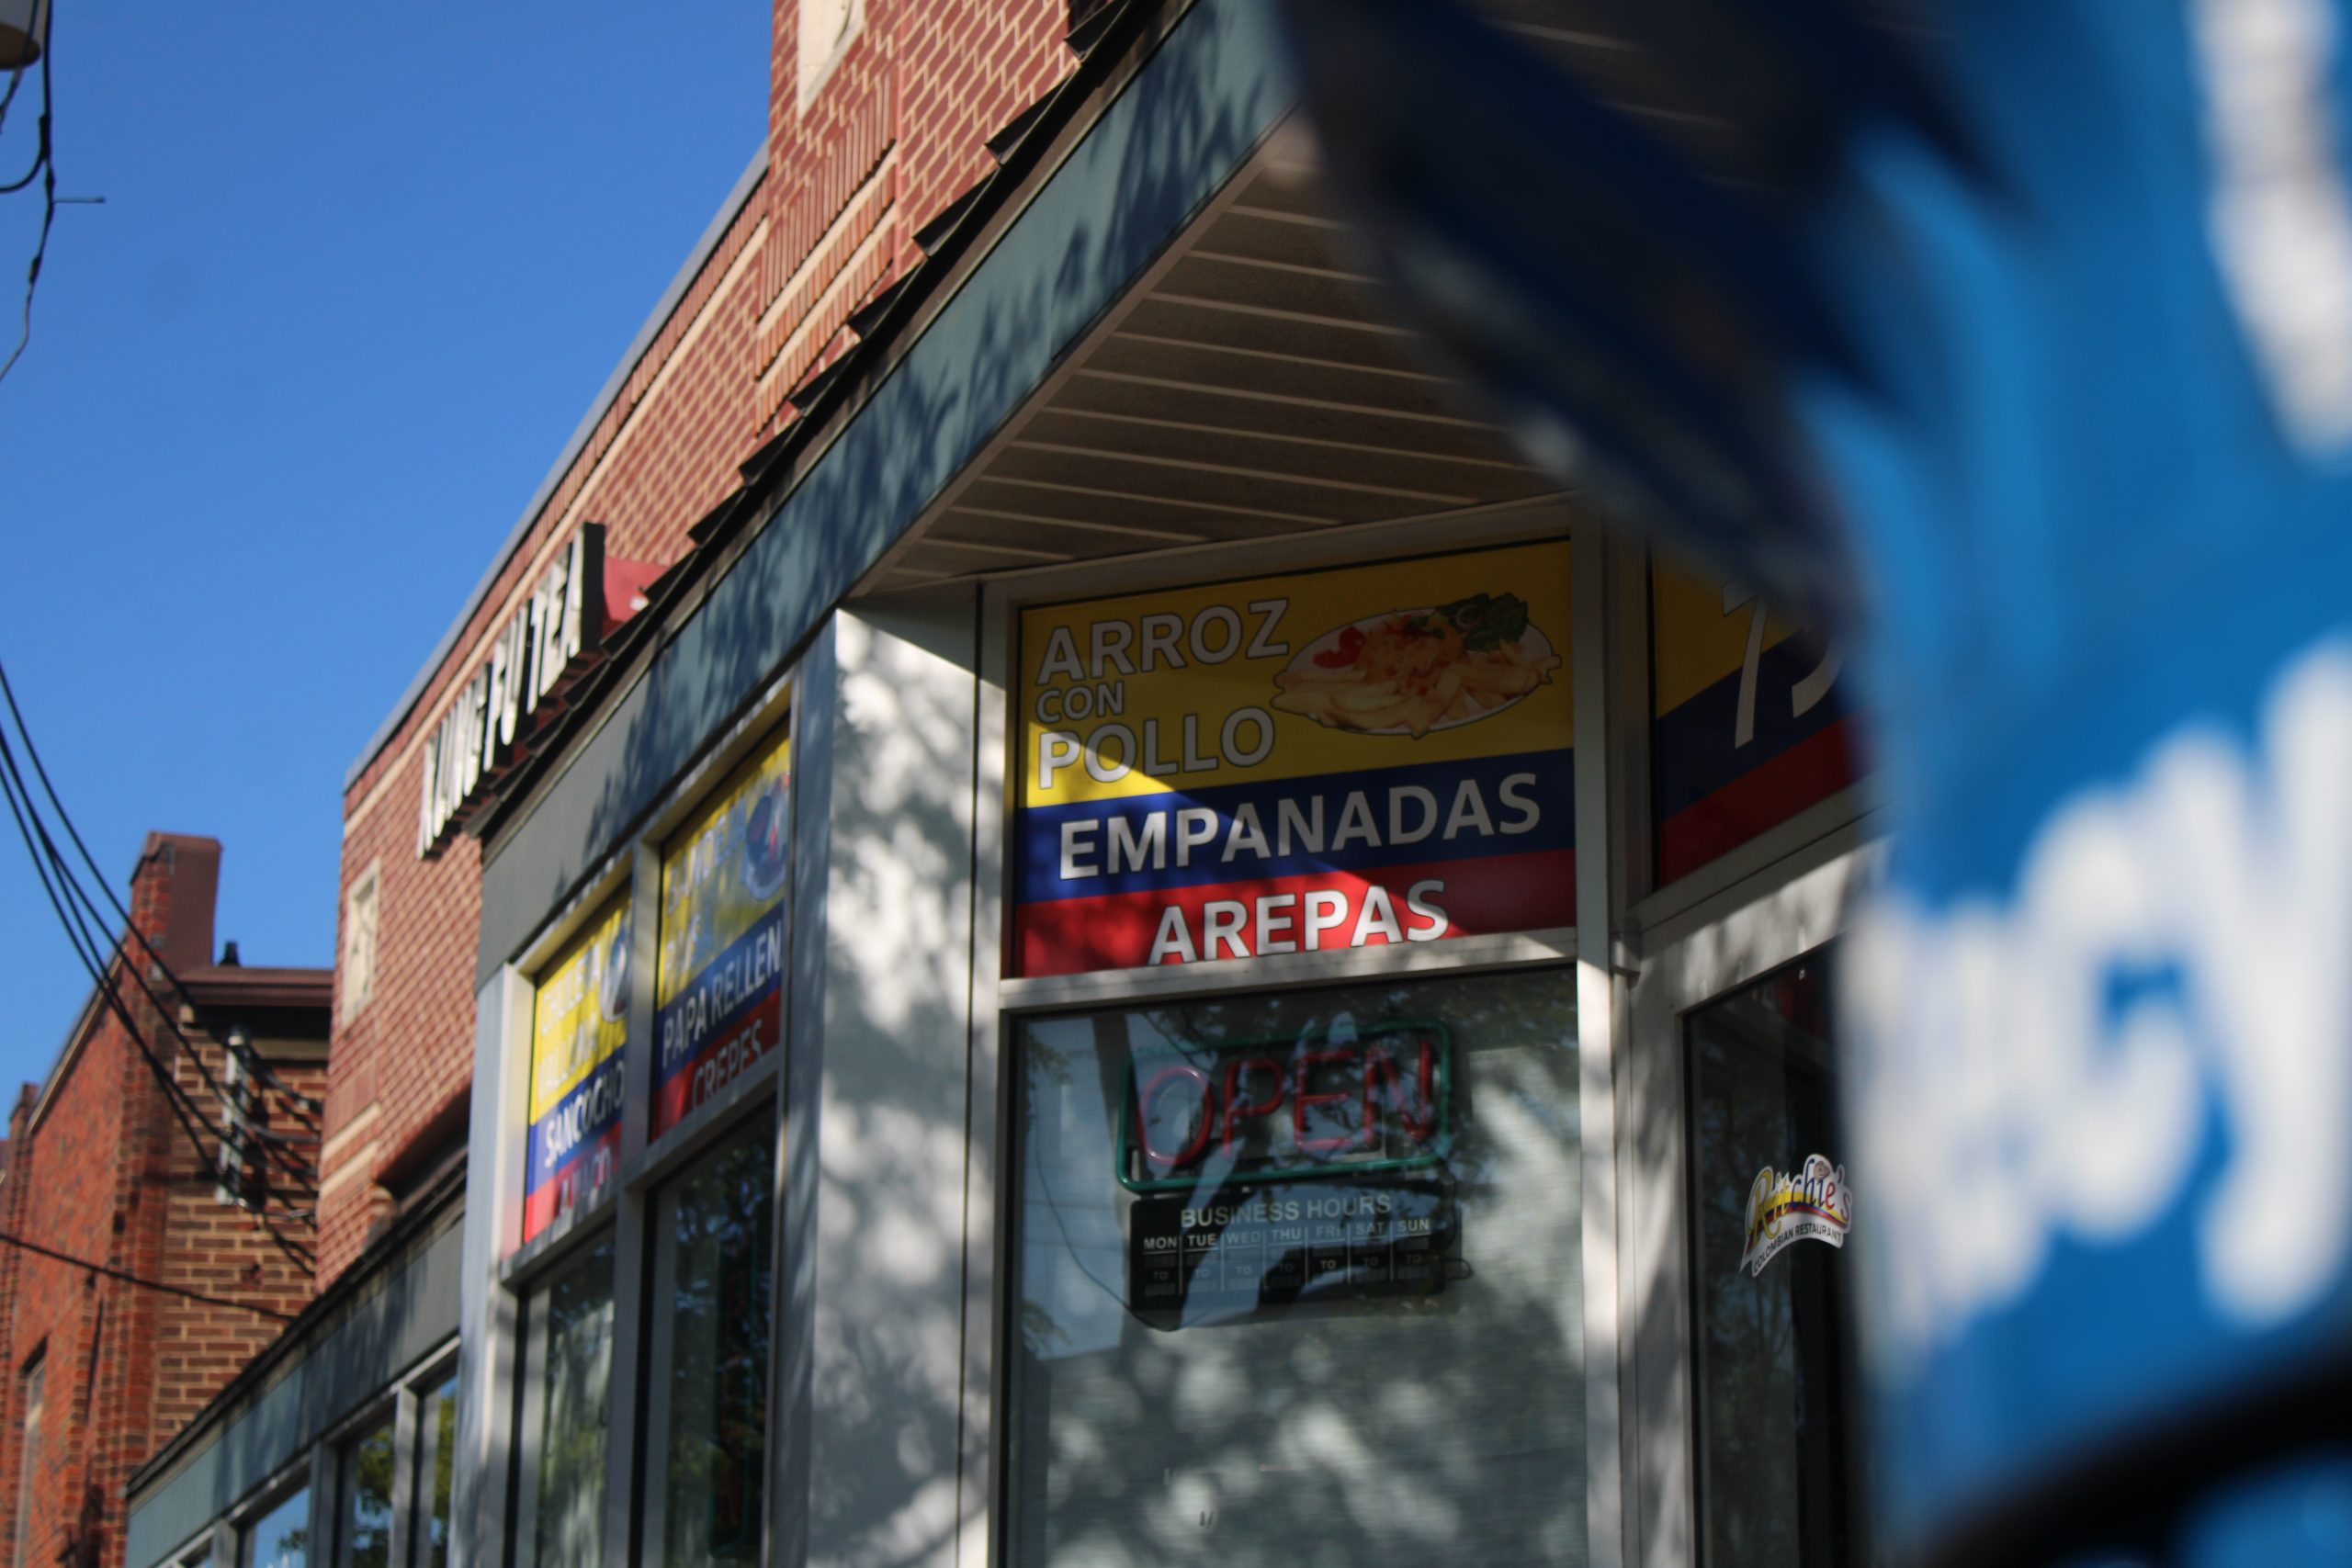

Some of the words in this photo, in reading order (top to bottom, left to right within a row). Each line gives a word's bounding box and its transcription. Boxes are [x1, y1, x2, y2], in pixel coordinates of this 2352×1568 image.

[1035, 598, 1290, 685] ARROZ
[1035, 682, 1125, 724] CON
[1038, 706, 1276, 790] POLLO
[1059, 773, 1542, 881] EMPANADAS
[1148, 879, 1450, 966] AREPAS
[663, 987, 707, 1070] PAPA
[711, 920, 781, 1026] RELLEN
[693, 1019, 763, 1108] CREPES
[1136, 1041, 1434, 1166] OPEN
[1143, 1236, 1177, 1250] MON
[1187, 1234, 1216, 1247] TUE
[1227, 1231, 1261, 1245] WED
[1271, 1228, 1302, 1241] THU
[1316, 1224, 1341, 1238] FRI
[1356, 1222, 1384, 1235] SAT
[1397, 1219, 1430, 1233] SUN
[1181, 1201, 1300, 1229] BUSINESS
[1306, 1195, 1392, 1220] HOURS
[1320, 1259, 1337, 1270] TO
